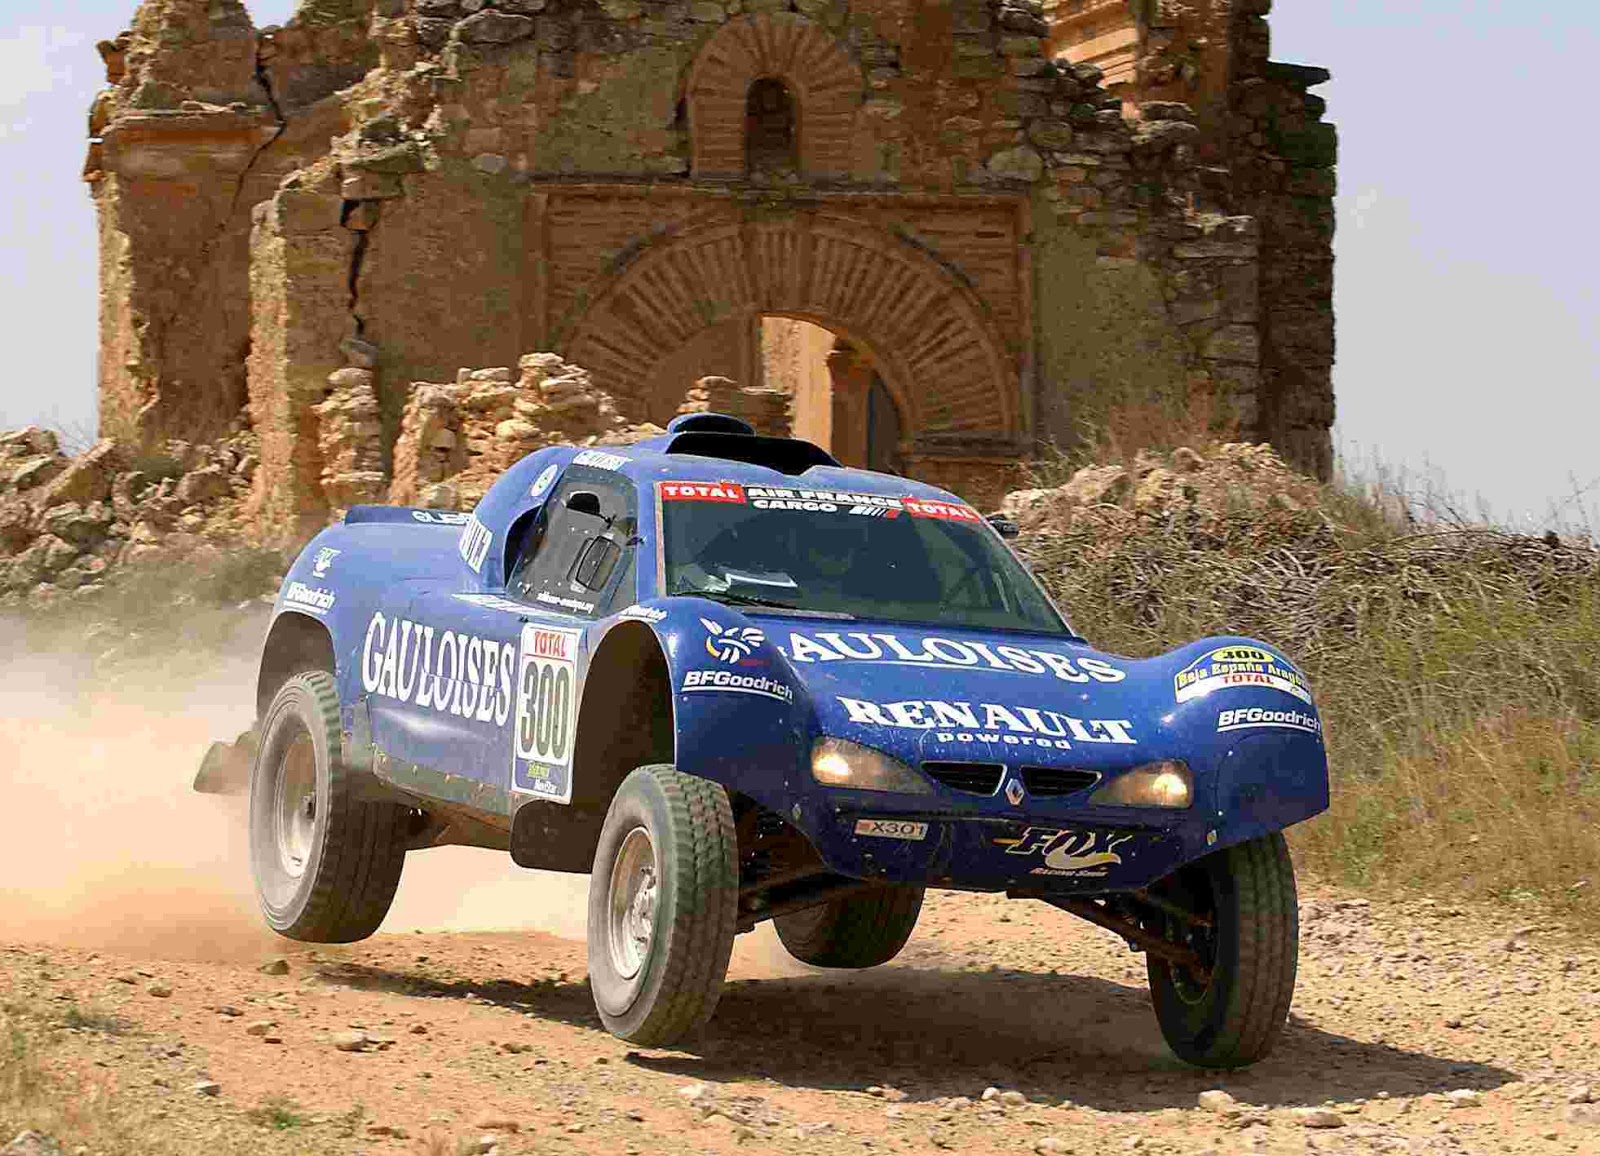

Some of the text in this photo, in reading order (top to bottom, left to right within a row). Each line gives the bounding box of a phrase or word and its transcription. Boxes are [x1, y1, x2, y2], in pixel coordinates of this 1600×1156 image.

[663, 485, 739, 500] TOTAL
[747, 488, 903, 508] AIR FRANCE
[752, 499, 838, 513] CARGO
[907, 501, 979, 520] TOTAL
[534, 630, 567, 658] TOTAL
[361, 611, 515, 727] GAULOISES
[777, 632, 1127, 684] AULOISES
[683, 671, 794, 701] BFGoodrich
[1222, 673, 1275, 686] TOTAL
[520, 661, 570, 760] 300
[836, 695, 1138, 745] RENAULT
[1218, 707, 1322, 732] BFGoodrich
[936, 731, 1073, 750] powered
[872, 821, 926, 836] X301
